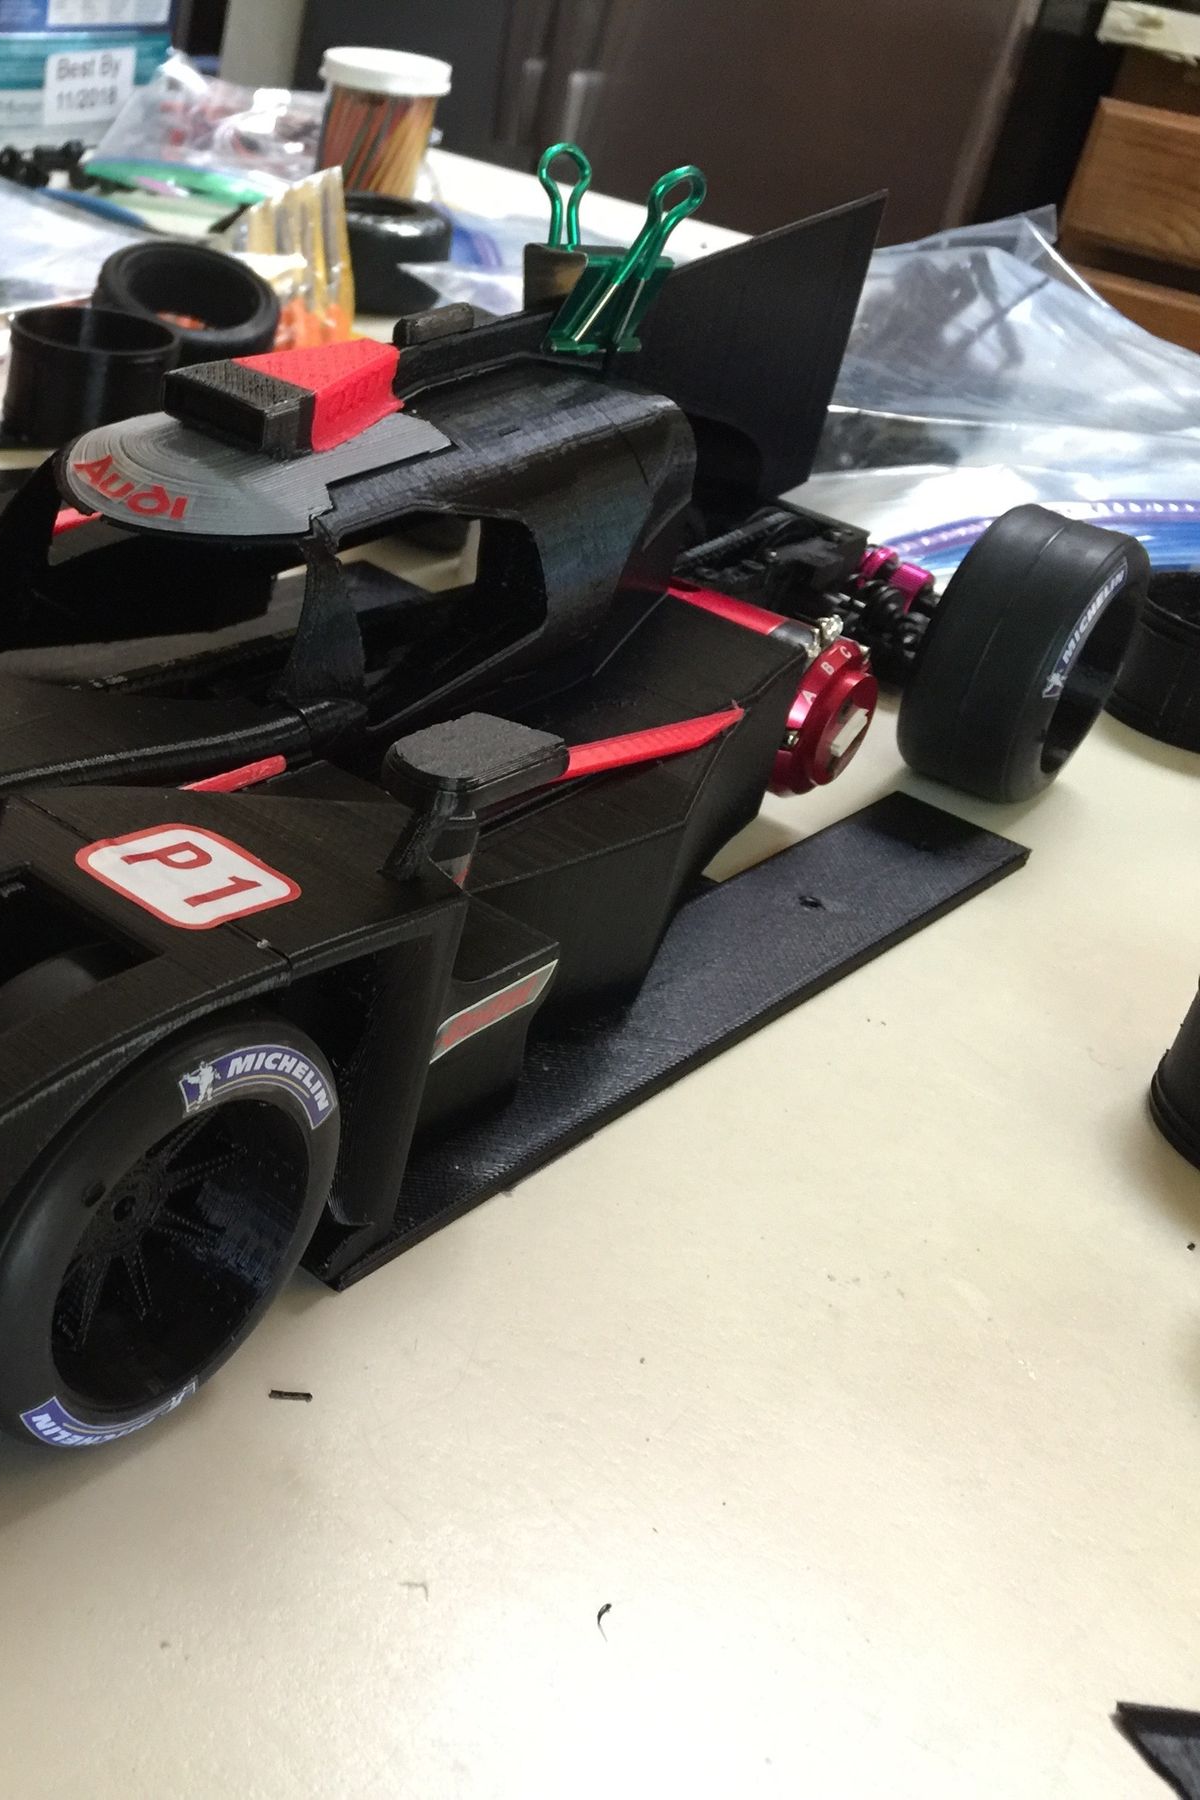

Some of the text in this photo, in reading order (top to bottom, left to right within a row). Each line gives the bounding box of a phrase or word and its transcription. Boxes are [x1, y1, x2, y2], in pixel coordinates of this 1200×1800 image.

[55, 57, 95, 81] Best
[100, 53, 122, 79] By
[1062, 569, 1125, 664] MICHELIN
[820, 661, 835, 676] B
[120, 840, 262, 908] P1
[226, 1052, 330, 1112] MICHELIN
